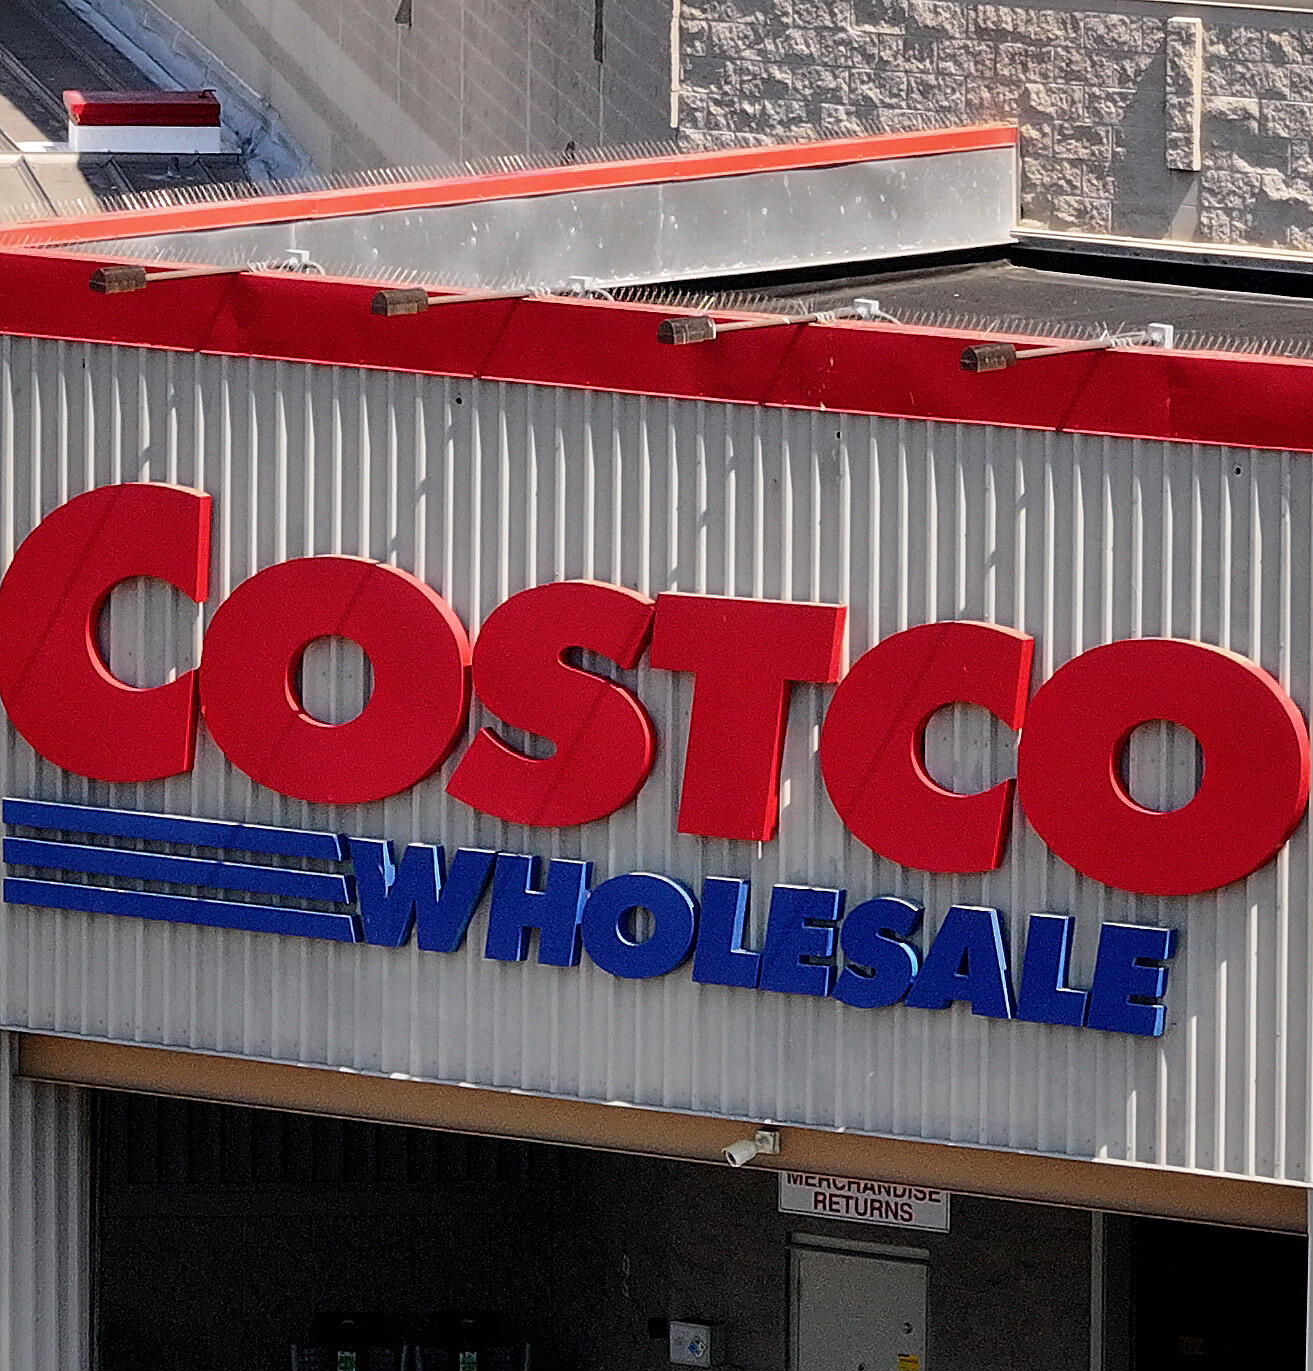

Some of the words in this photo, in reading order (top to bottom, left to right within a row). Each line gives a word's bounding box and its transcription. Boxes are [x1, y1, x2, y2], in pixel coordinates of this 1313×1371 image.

[346, 838, 1179, 1038] WHOLESALE
[787, 1172, 942, 1204] MERCHANDISE
[813, 1191, 914, 1223] RETURNS
